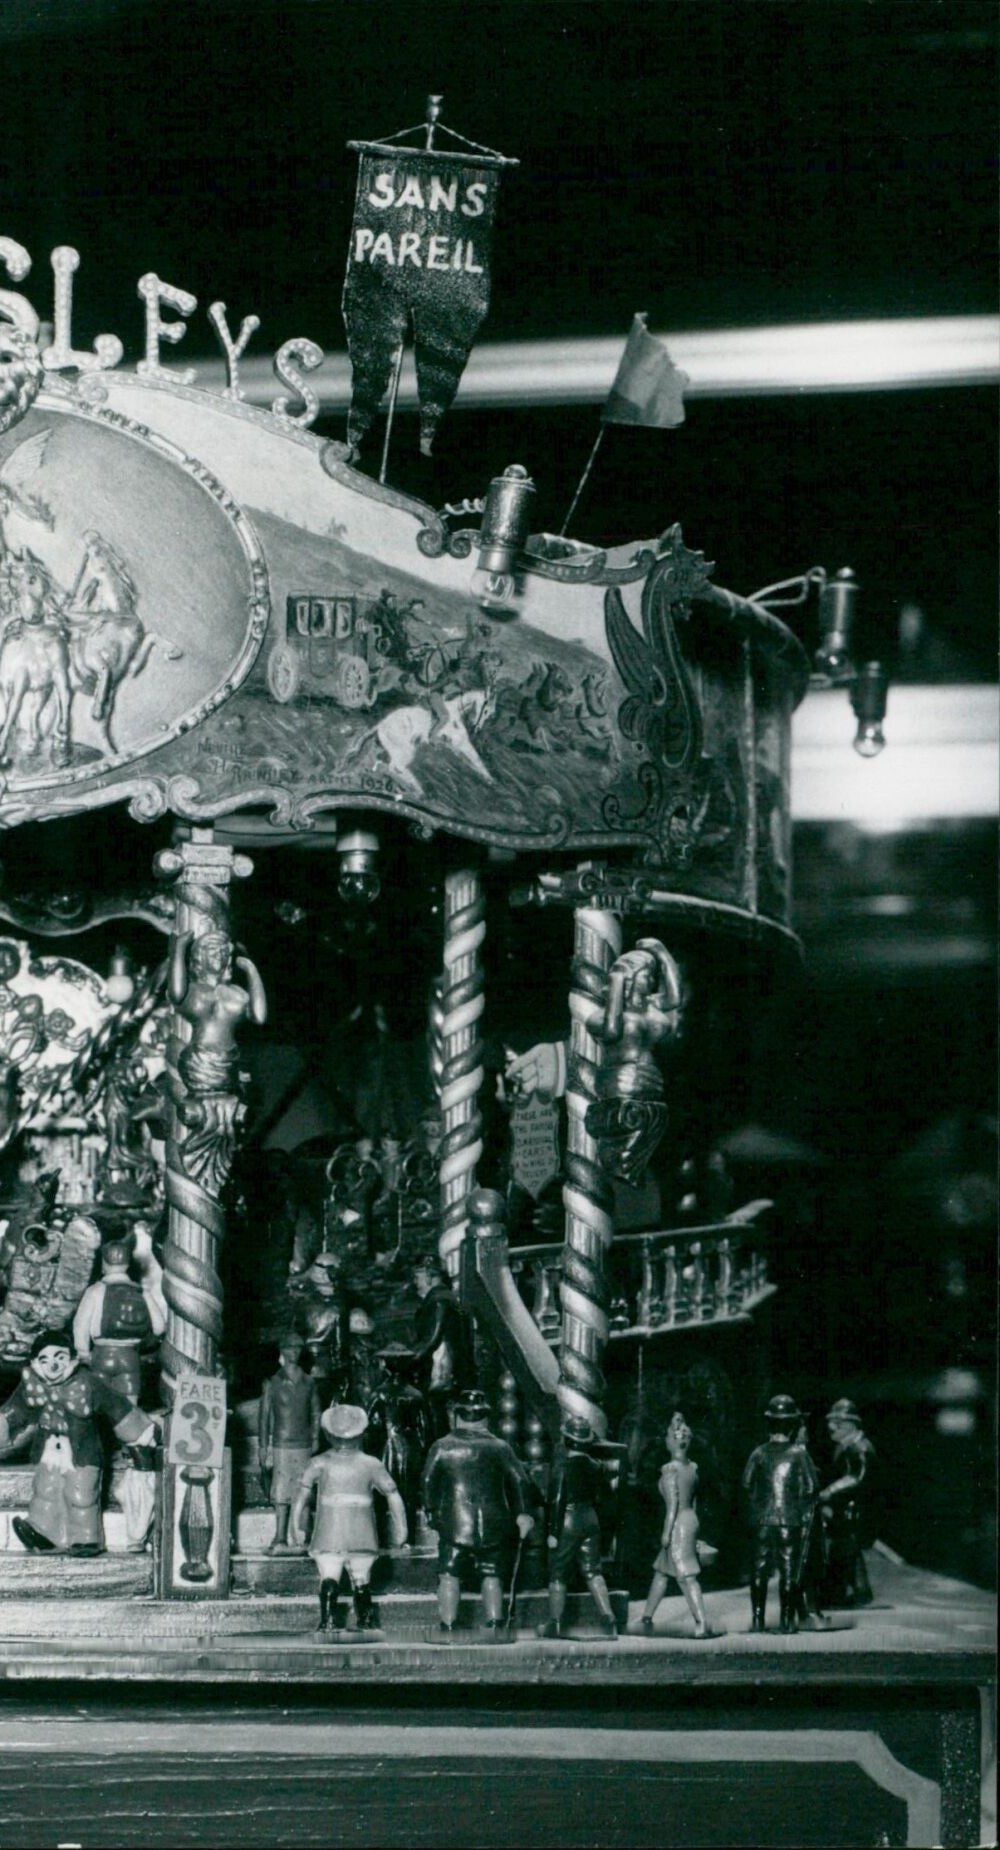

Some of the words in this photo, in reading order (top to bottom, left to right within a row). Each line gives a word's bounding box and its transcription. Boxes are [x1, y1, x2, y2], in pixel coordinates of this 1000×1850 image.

[368, 173, 488, 218] SANS
[354, 228, 484, 274] PAREIL
[181, 1381, 222, 1401] FARE
